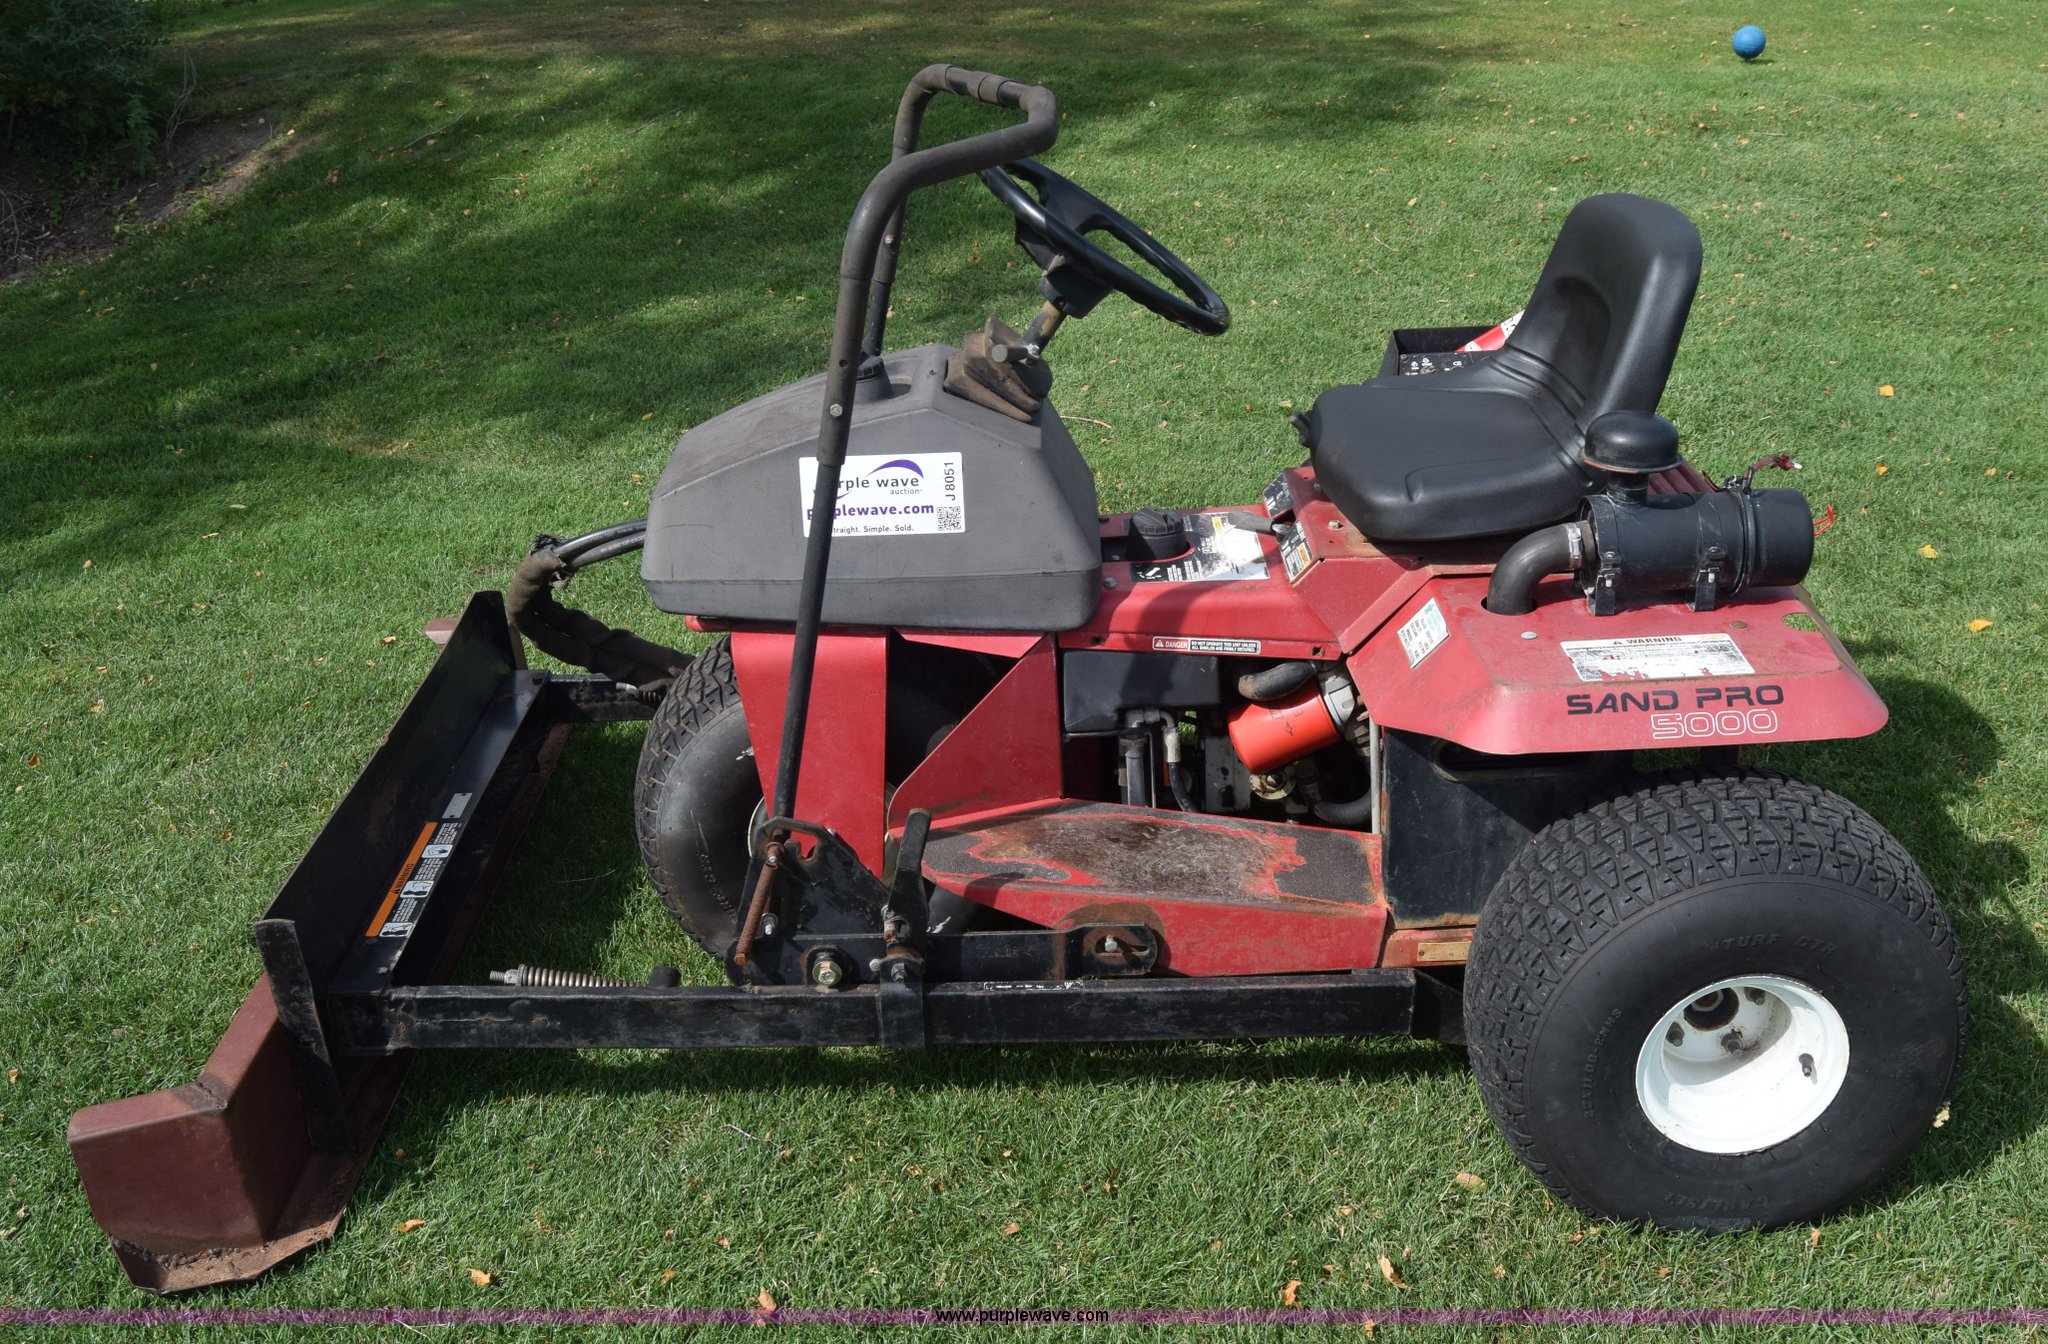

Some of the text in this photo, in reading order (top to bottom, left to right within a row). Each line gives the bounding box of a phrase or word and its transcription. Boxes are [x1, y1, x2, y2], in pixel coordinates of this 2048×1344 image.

[876, 477, 919, 488] wave
[944, 462, 955, 491] 8051
[807, 504, 934, 520] pplewave.com
[832, 524, 914, 534] traight. Simple. Sold.
[1165, 640, 1188, 649] DANGER
[1625, 636, 1682, 645] WARNING
[1566, 685, 1784, 715] SAND PRO
[1651, 709, 1778, 740] 5000
[1722, 933, 1837, 954] TURF CTR
